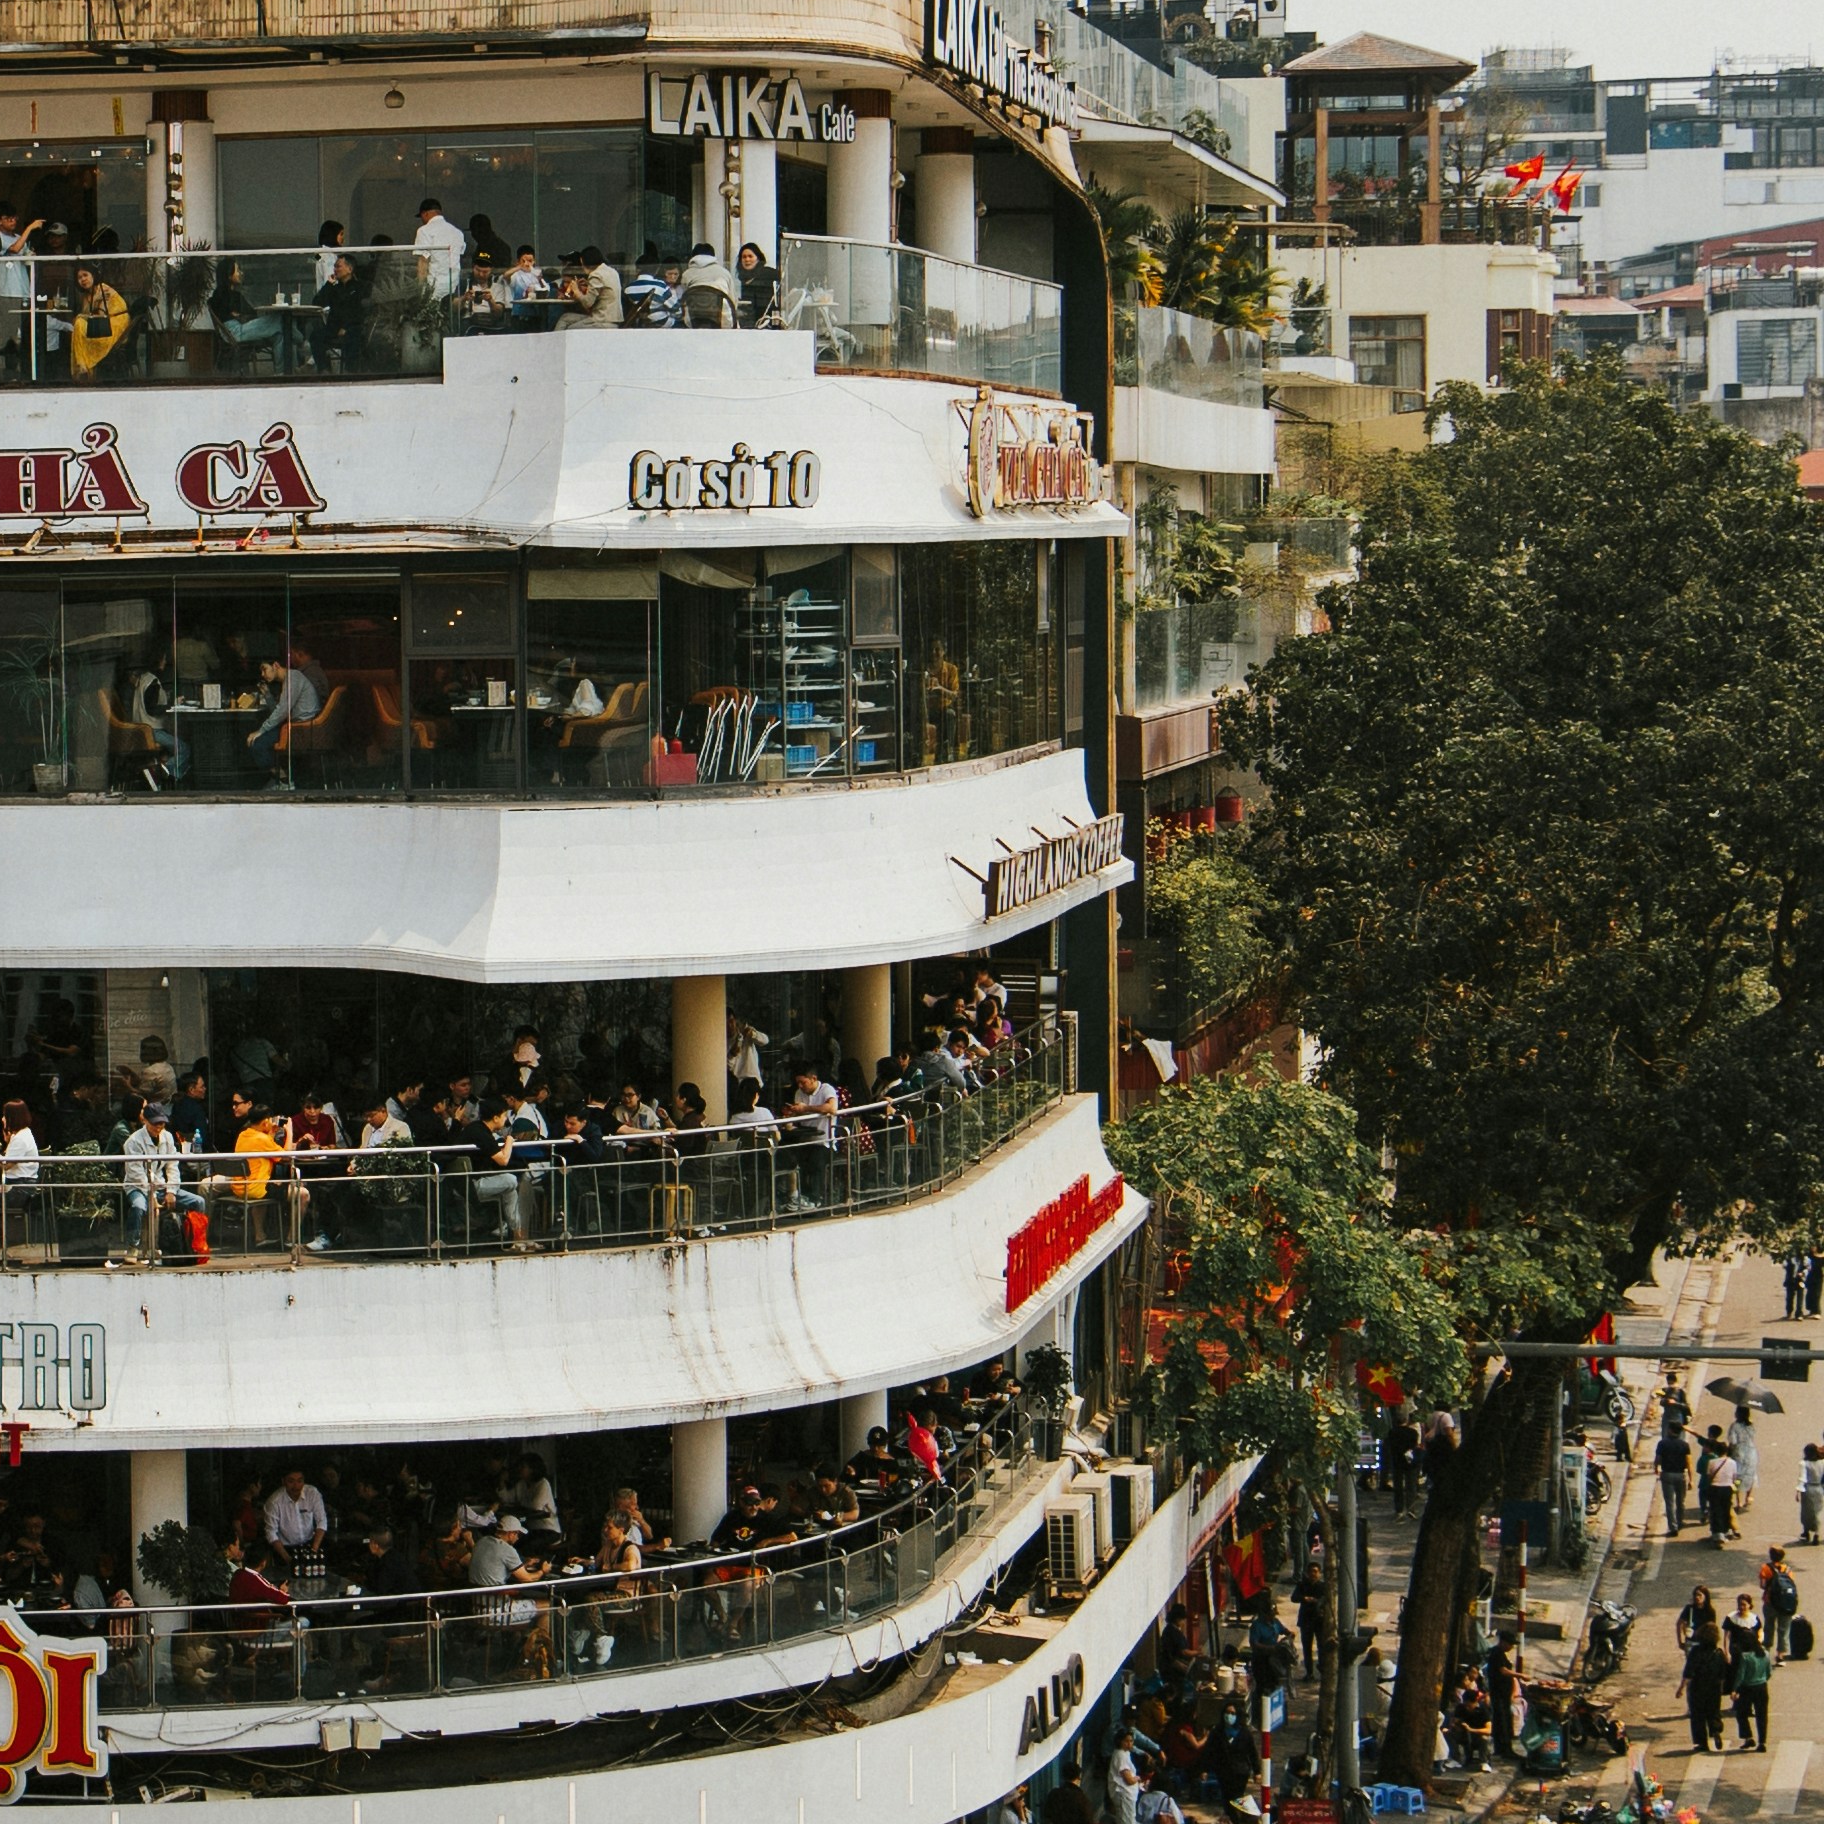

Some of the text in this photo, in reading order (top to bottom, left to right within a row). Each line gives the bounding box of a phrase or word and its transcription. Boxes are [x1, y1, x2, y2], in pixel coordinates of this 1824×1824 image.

[649, 72, 856, 143] LAIKA Café
[175, 422, 327, 515] CÁ
[629, 442, 821, 509] Cơ sở 10
[987, 830, 1081, 917] HIGHLANDS
[1018, 1653, 1084, 1756] ALDO
